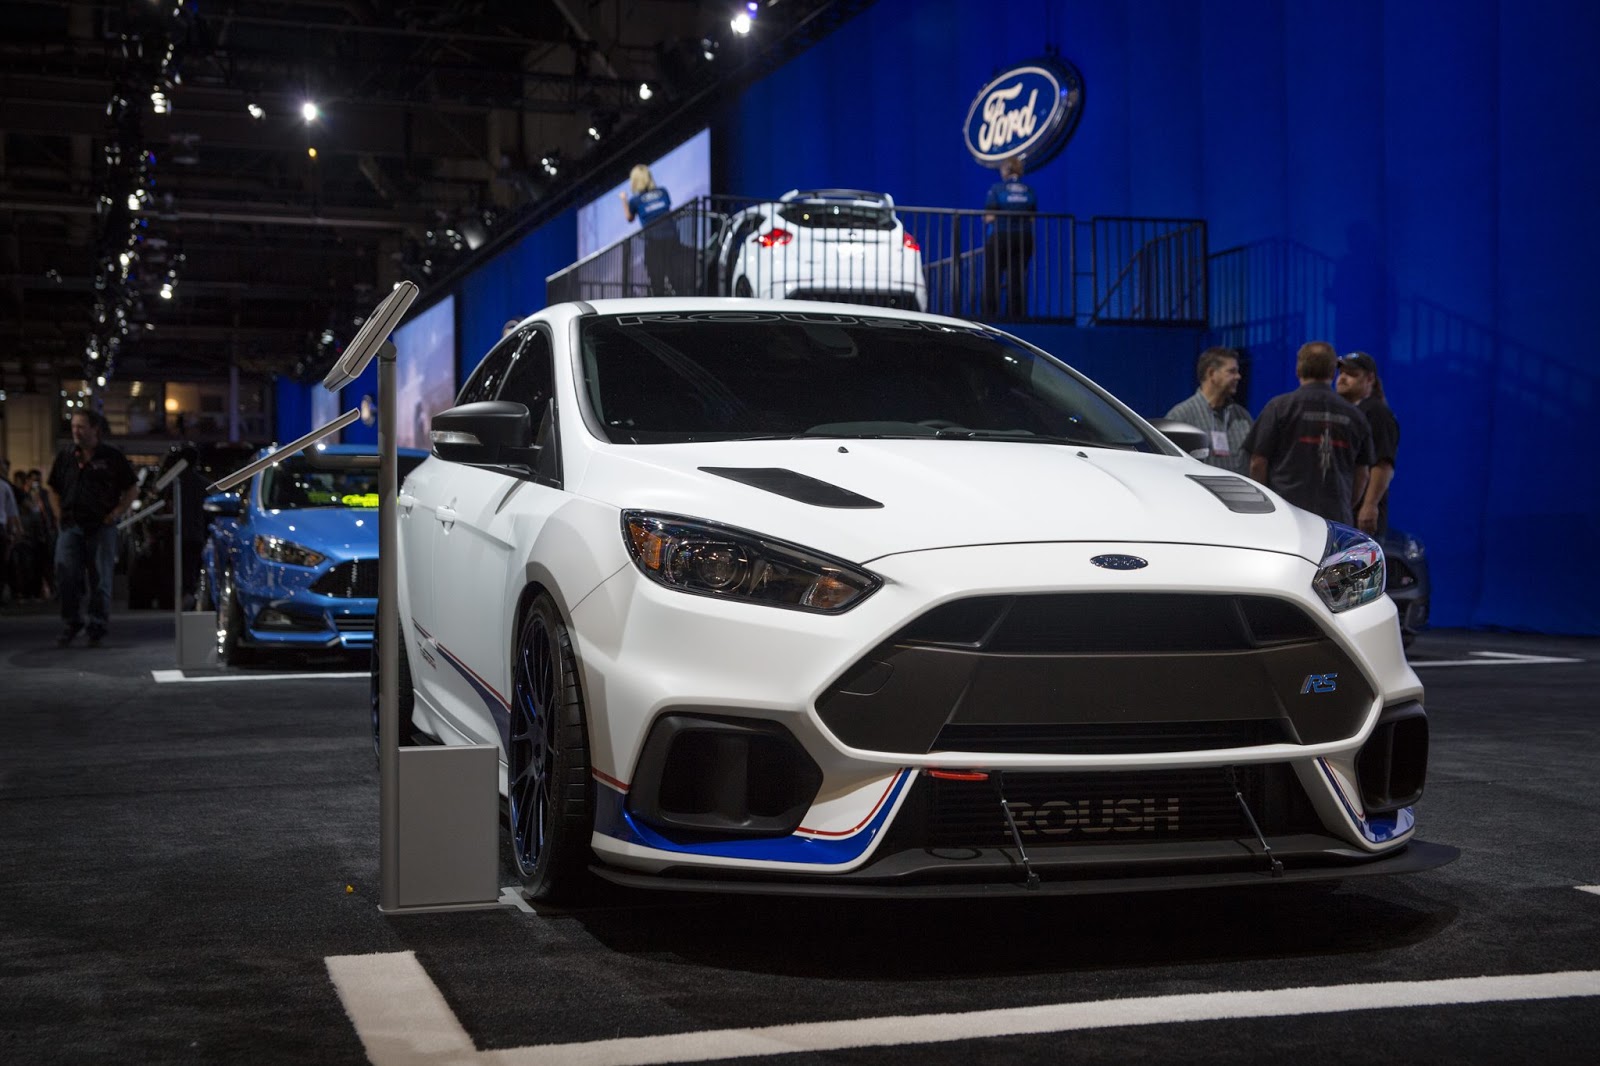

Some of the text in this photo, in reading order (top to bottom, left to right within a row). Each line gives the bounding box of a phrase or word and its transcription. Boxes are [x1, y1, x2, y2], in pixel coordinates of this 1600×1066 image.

[978, 82, 1038, 153] Ford
[1300, 673, 1338, 694] RS
[1003, 798, 1179, 835] ROUSH
